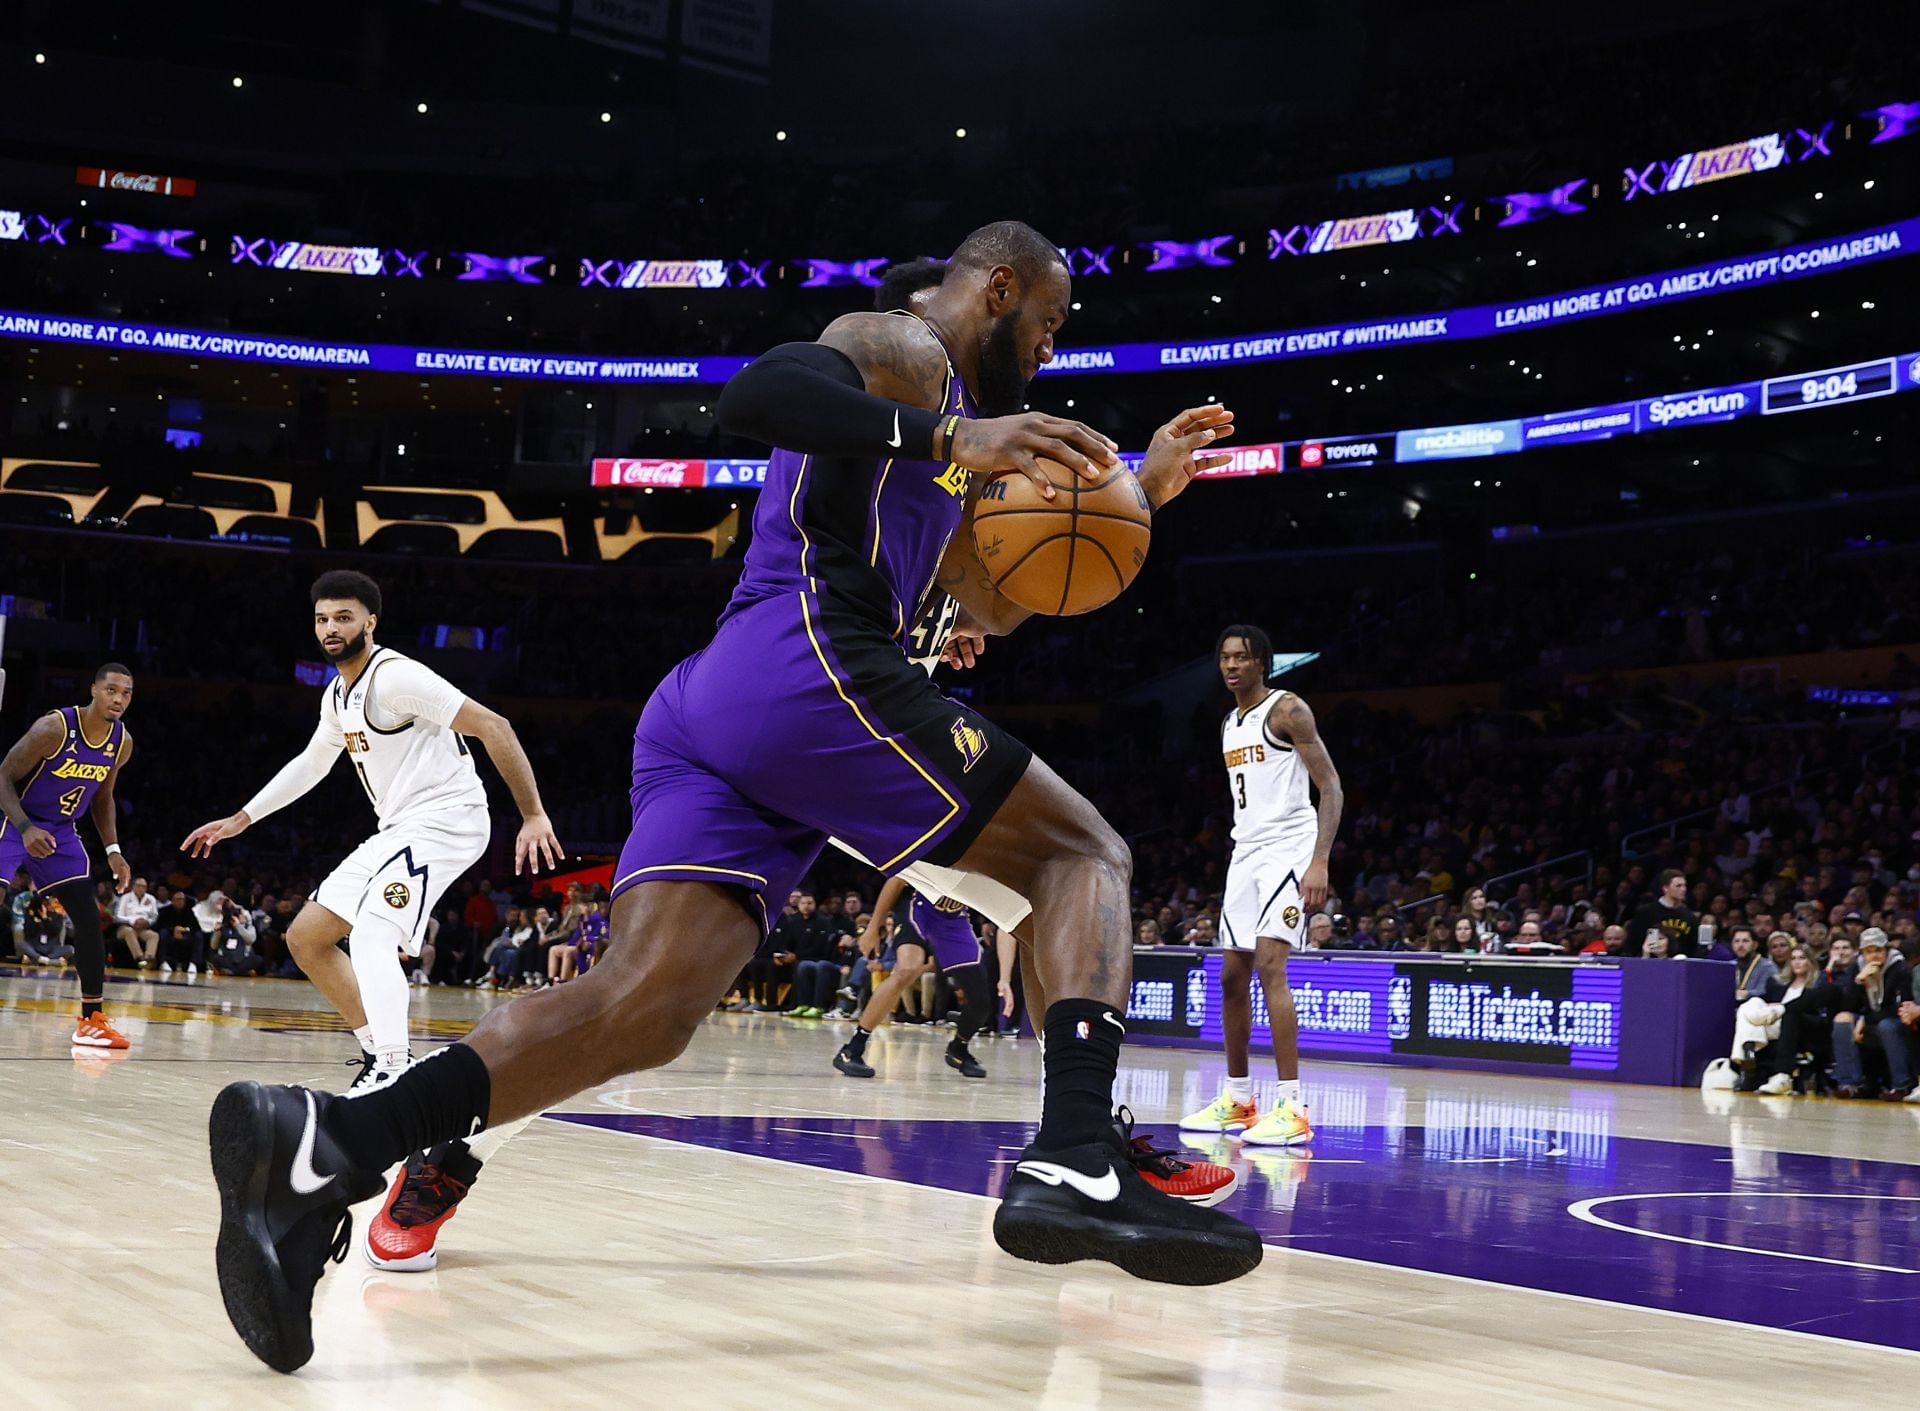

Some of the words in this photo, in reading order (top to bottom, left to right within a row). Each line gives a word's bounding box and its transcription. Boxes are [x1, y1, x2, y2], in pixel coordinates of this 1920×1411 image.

[1495, 303, 1550, 328] LEARN
[1552, 292, 1601, 317] MORE
[1603, 287, 1626, 308] AT
[43, 320, 94, 340] MORE
[96, 326, 119, 341] AT
[1160, 344, 1231, 364] ELEVATE
[1233, 337, 1285, 358] EVERY
[1286, 331, 1340, 353] EVENT
[1342, 318, 1447, 346] #WITHAMEX
[416, 352, 485, 370] ELEVATE
[488, 356, 542, 374] EVERY
[544, 359, 598, 376] EVENT
[600, 361, 699, 378] #WITHAMEX
[1801, 372, 1858, 402] 9:04
[1649, 391, 1745, 426] Spectrum
[1526, 420, 1580, 439] AMERICAN
[1581, 413, 1631, 431] EXPRESS
[1325, 443, 1378, 459] TOYOTA
[51, 758, 111, 782] LAKERS
[59, 785, 86, 816] 4
[1236, 772, 1247, 810] 3
[1427, 983, 1613, 1048] NBATickets.com
